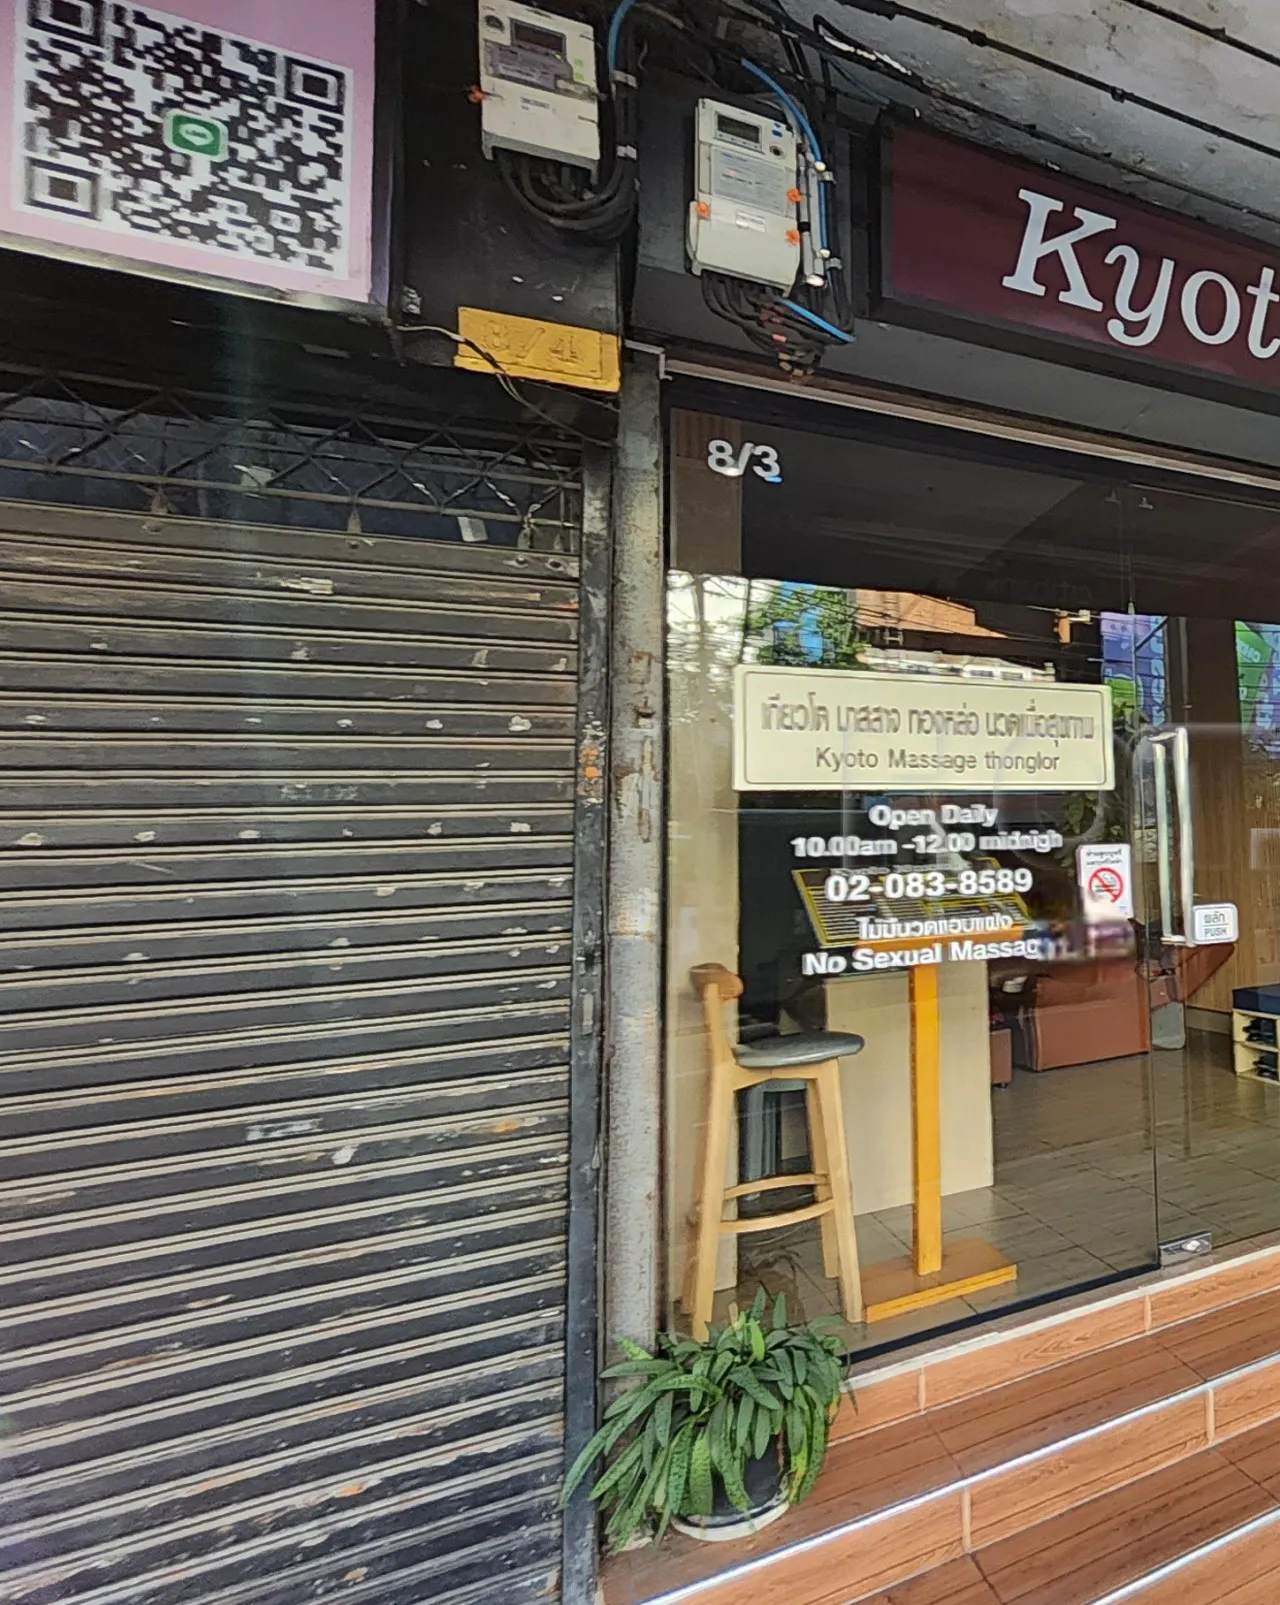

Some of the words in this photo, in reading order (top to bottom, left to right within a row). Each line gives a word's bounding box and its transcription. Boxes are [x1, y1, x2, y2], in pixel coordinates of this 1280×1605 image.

[707, 438, 782, 484] 8/3
[815, 746, 879, 773] Kyoto
[888, 748, 977, 774] Massage
[984, 751, 1061, 775] thonglor
[868, 804, 936, 831] Open
[940, 803, 999, 828] Daily
[790, 835, 898, 858] 10.00am
[825, 867, 1034, 902] 02-083-8589
[1204, 927, 1227, 937] PUSH
[801, 951, 847, 976] No
[851, 943, 943, 971] Sexual
[948, 938, 1048, 962] Massag
